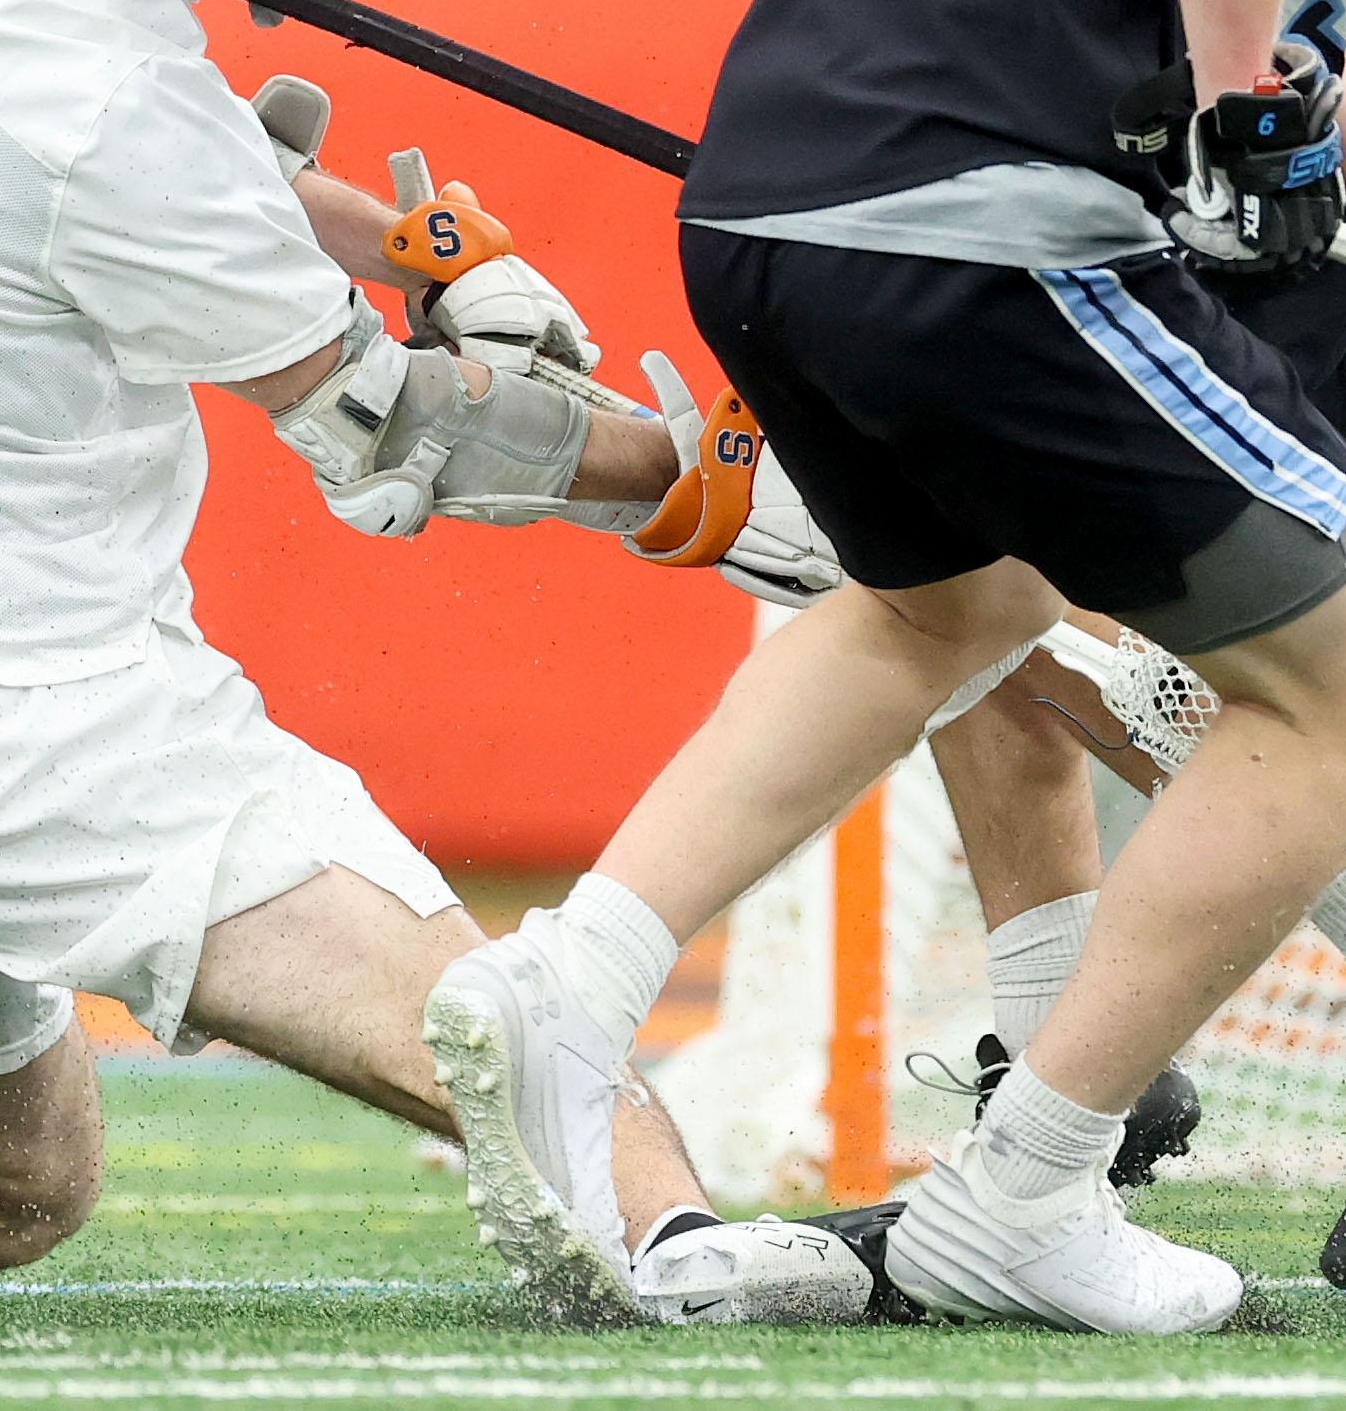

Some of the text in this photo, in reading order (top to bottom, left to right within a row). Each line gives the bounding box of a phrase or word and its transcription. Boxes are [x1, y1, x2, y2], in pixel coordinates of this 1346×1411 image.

[1257, 111, 1277, 137] 6
[425, 209, 462, 260] S
[1242, 193, 1262, 240] STX
[715, 427, 756, 469] S
